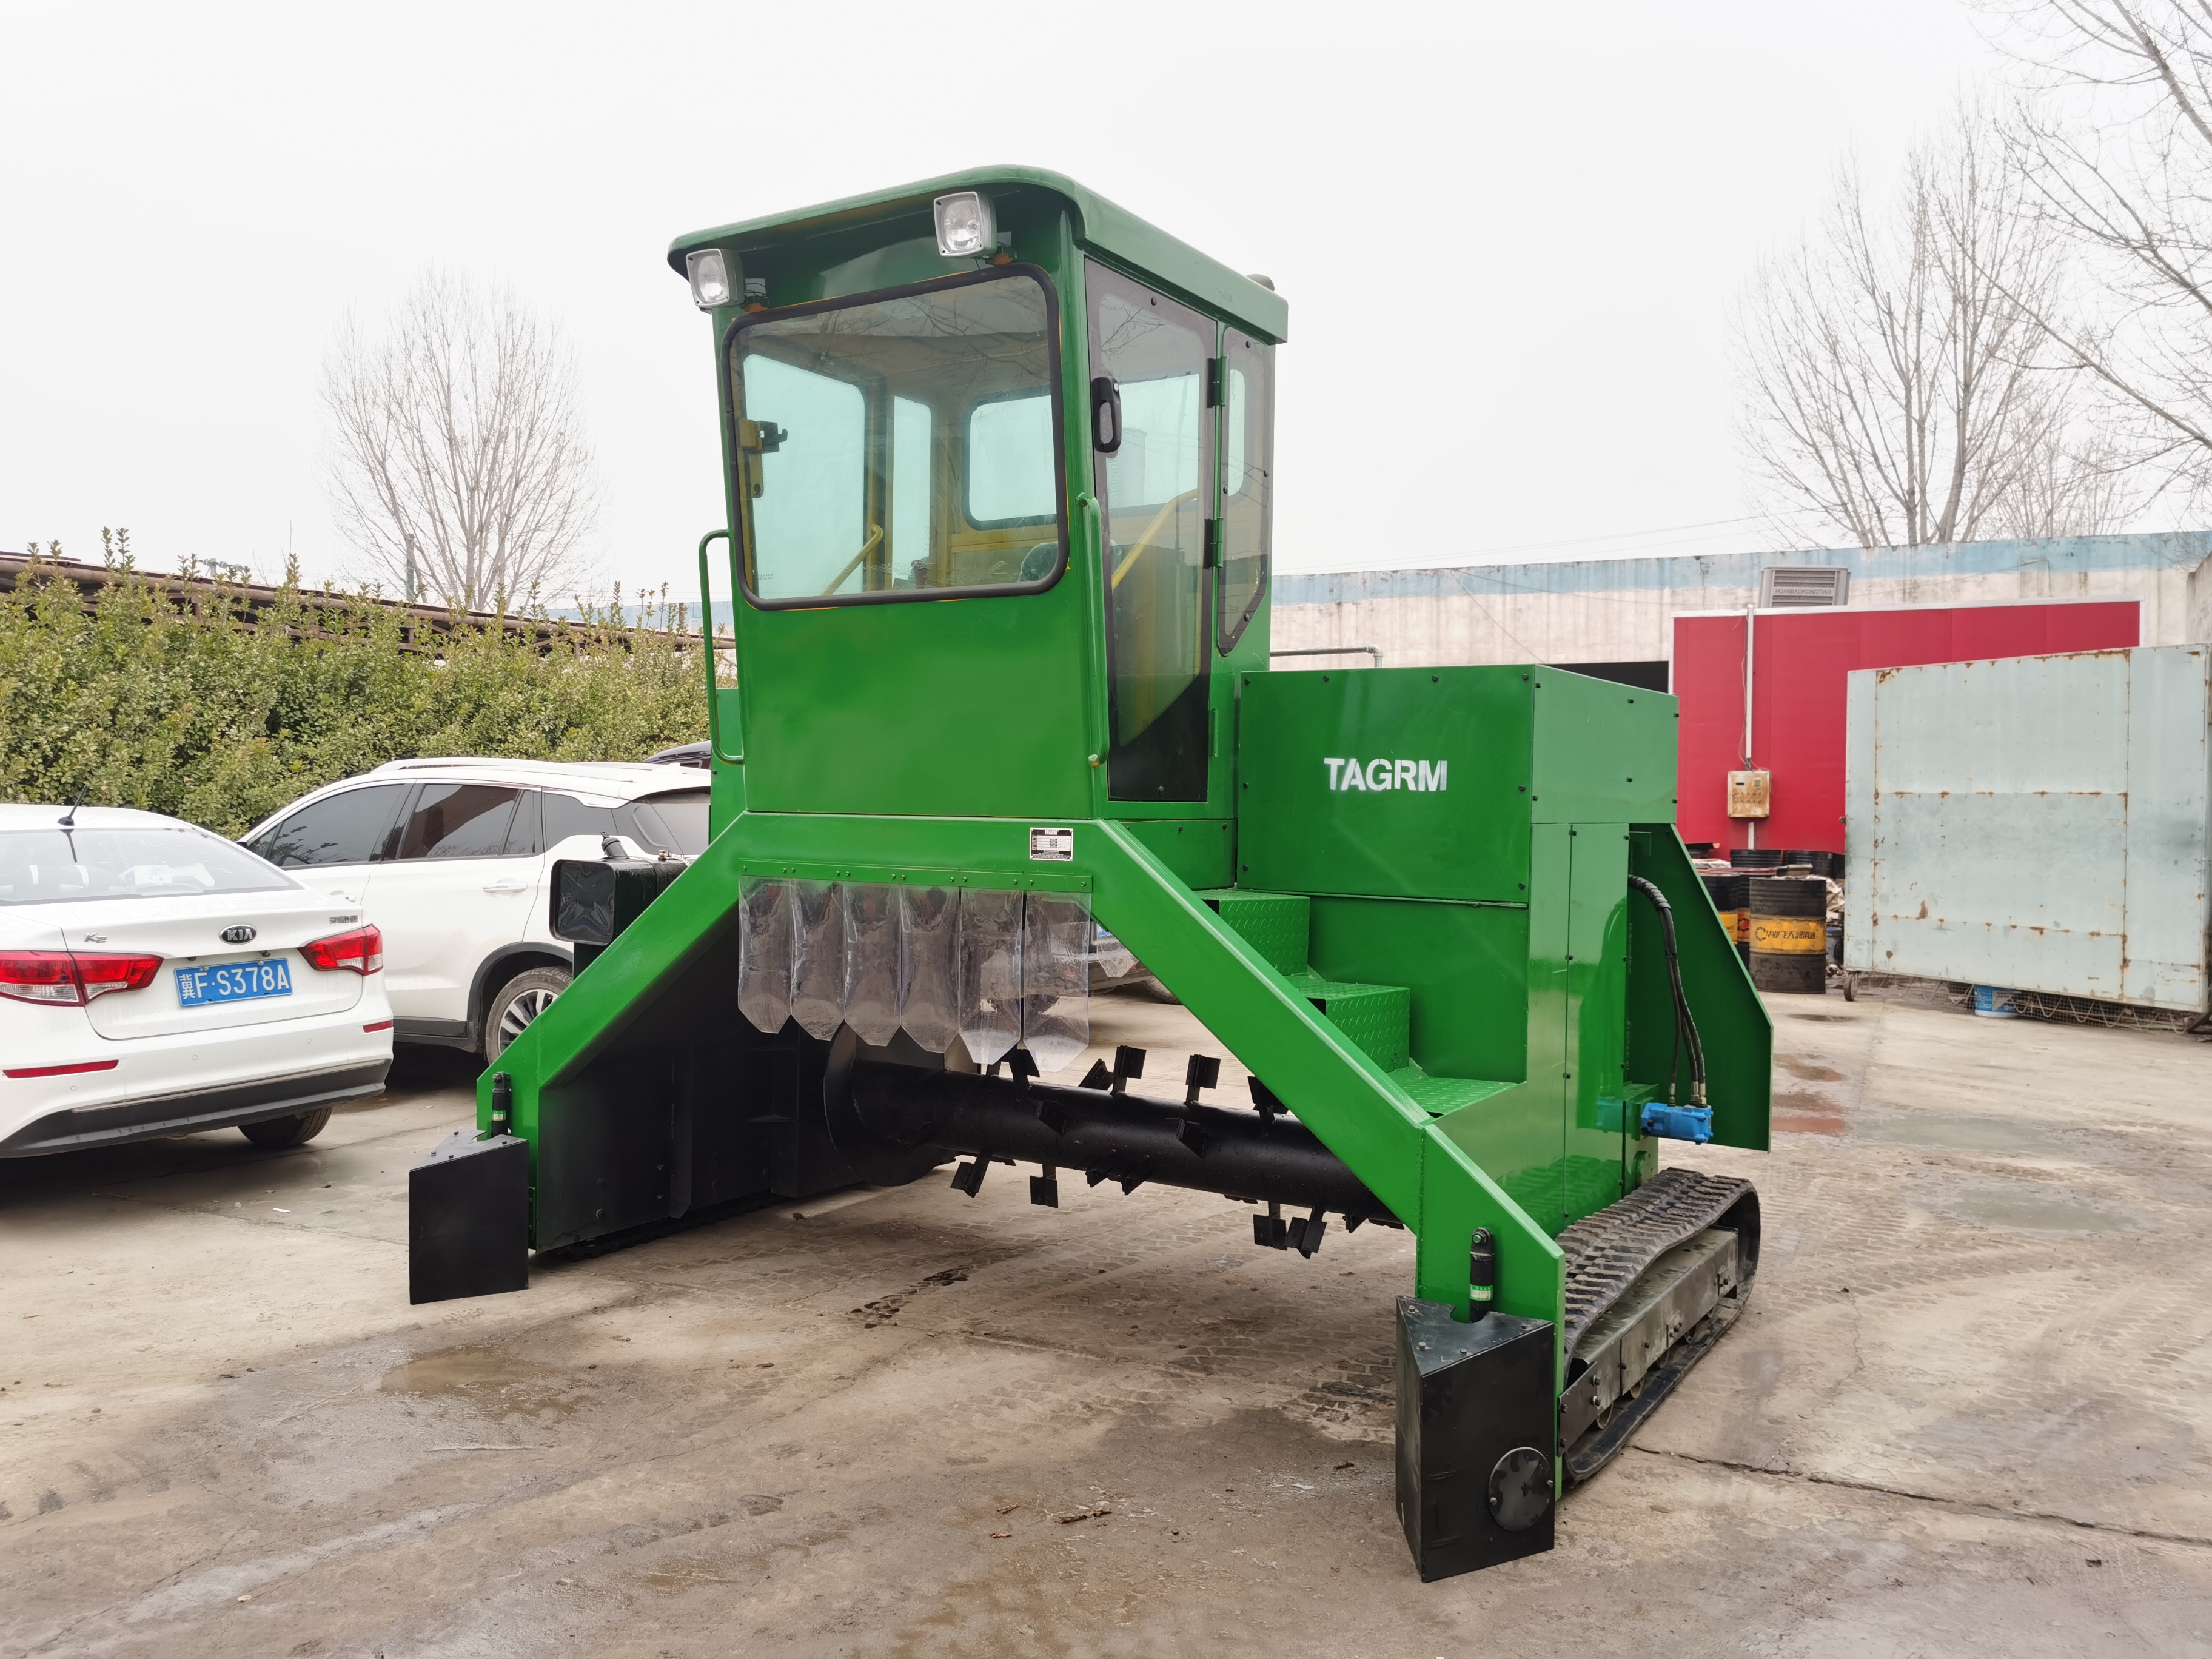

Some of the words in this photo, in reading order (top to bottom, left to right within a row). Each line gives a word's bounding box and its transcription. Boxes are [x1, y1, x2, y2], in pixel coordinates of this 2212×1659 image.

[1324, 757, 1447, 791] TAGRM
[84, 931, 107, 943] K2
[227, 928, 253, 941] KIA
